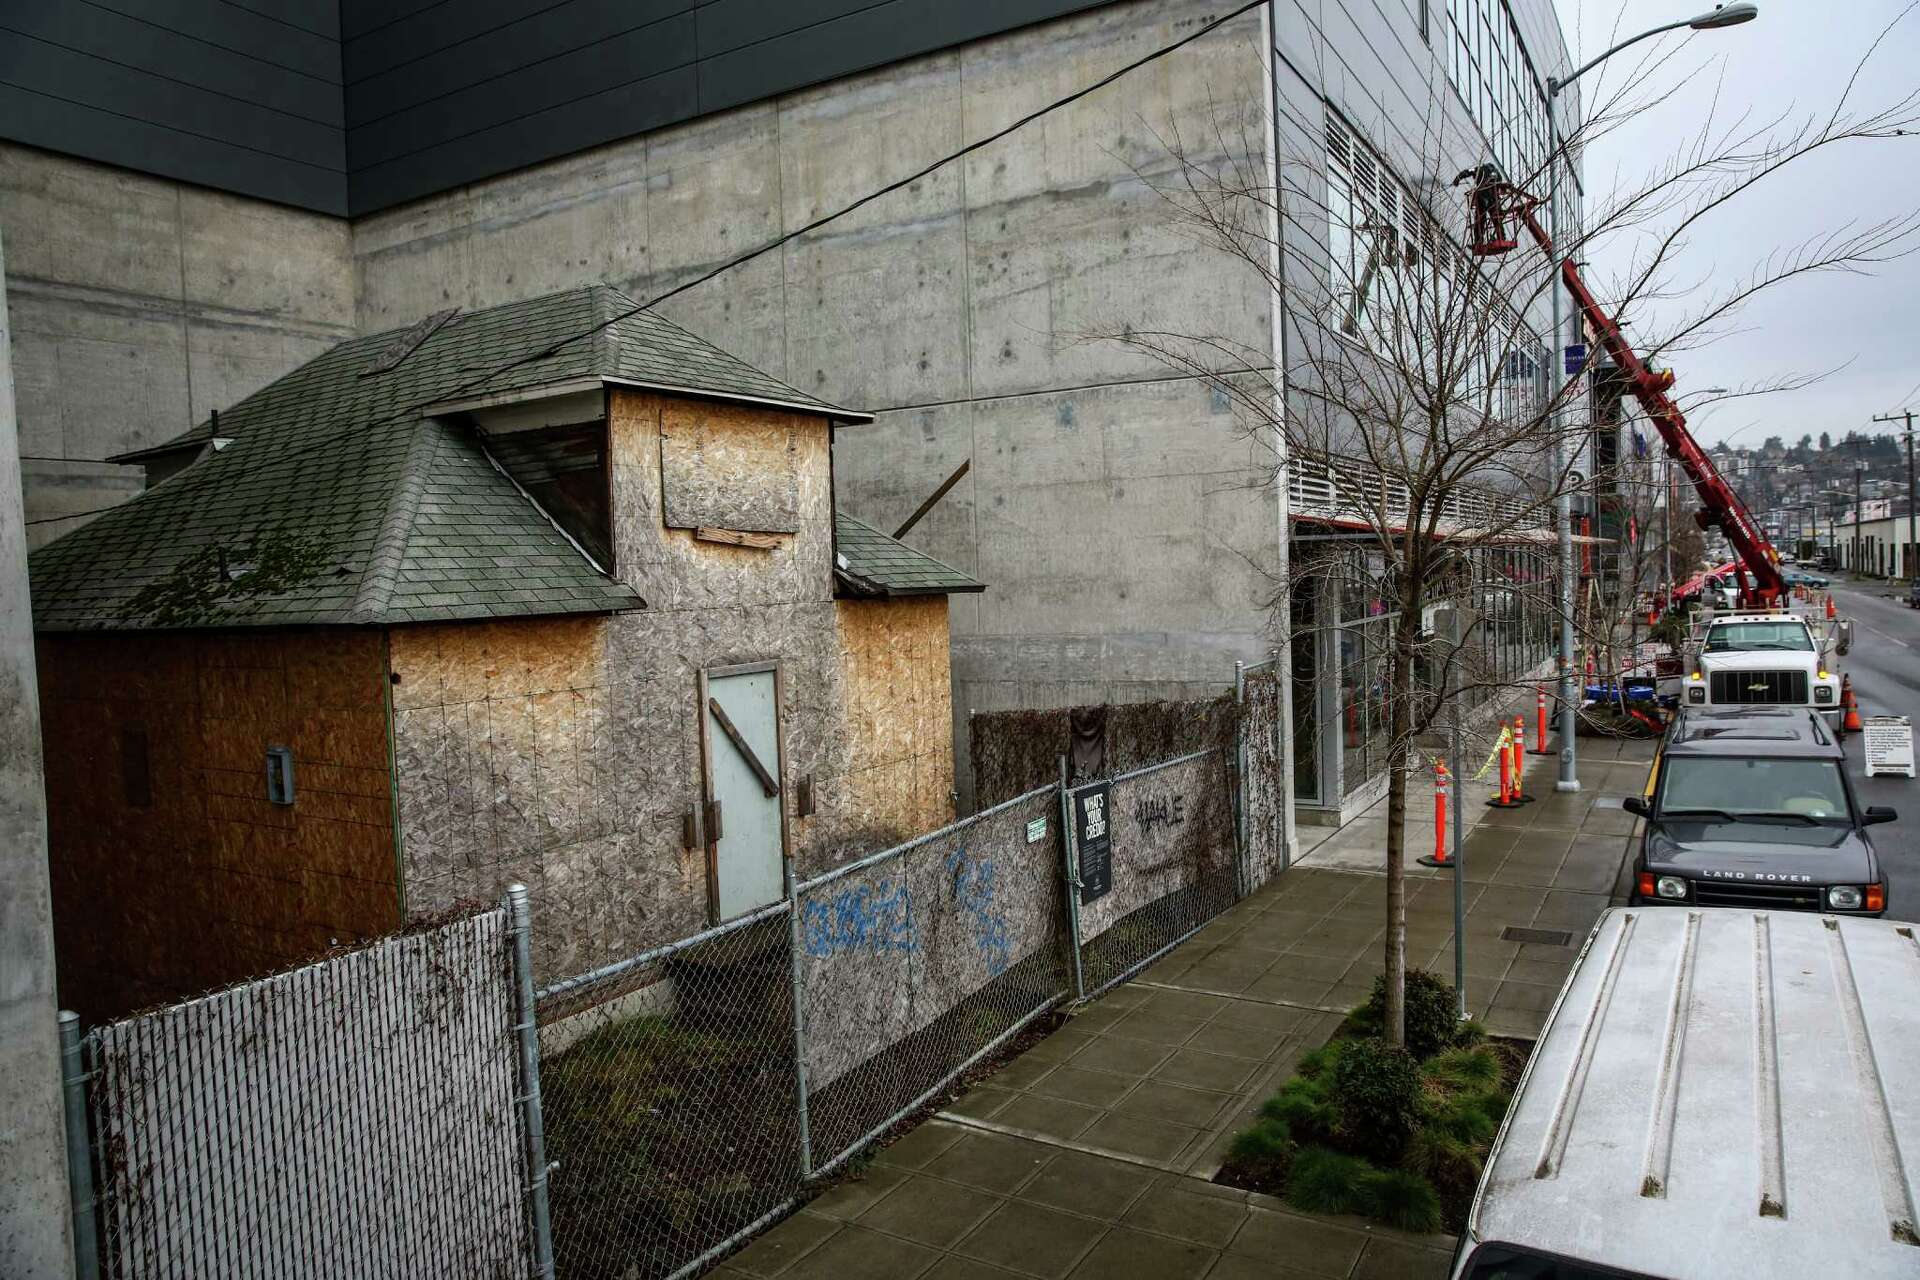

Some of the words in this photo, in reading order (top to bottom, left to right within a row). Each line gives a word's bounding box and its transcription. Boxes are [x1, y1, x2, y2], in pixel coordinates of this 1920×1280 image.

[1087, 807, 1102, 826] YOUR
[1703, 870, 1745, 879] LAND
[1755, 873, 1811, 882] ROVER
